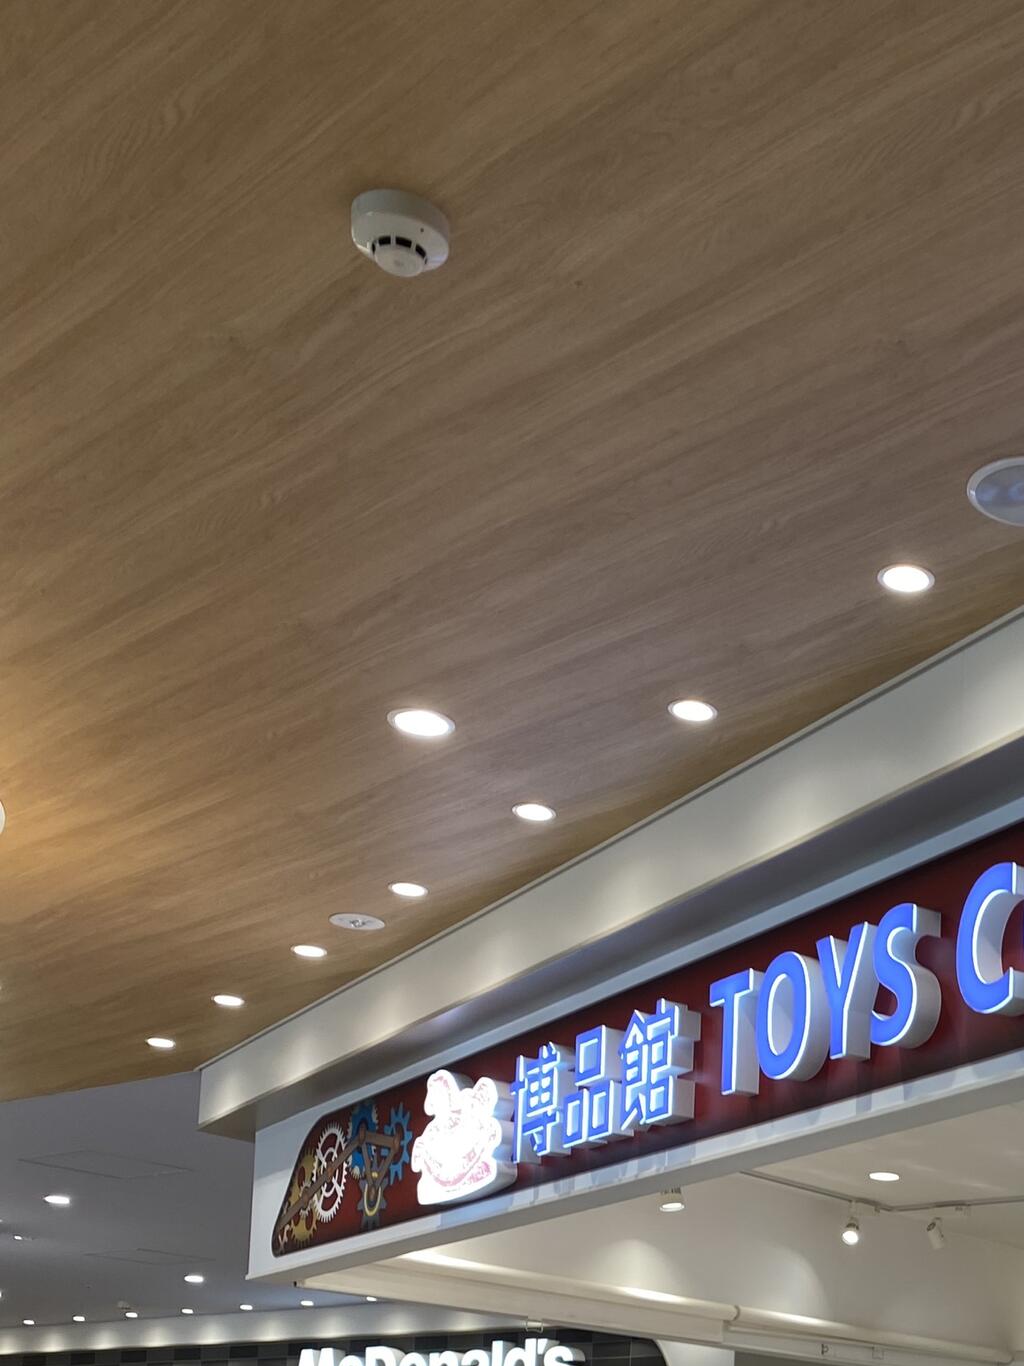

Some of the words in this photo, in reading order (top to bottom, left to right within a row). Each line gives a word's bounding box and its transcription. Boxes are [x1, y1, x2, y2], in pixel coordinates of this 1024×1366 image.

[511, 998, 698, 1164] 博品館
[709, 902, 938, 1096] TOYS
